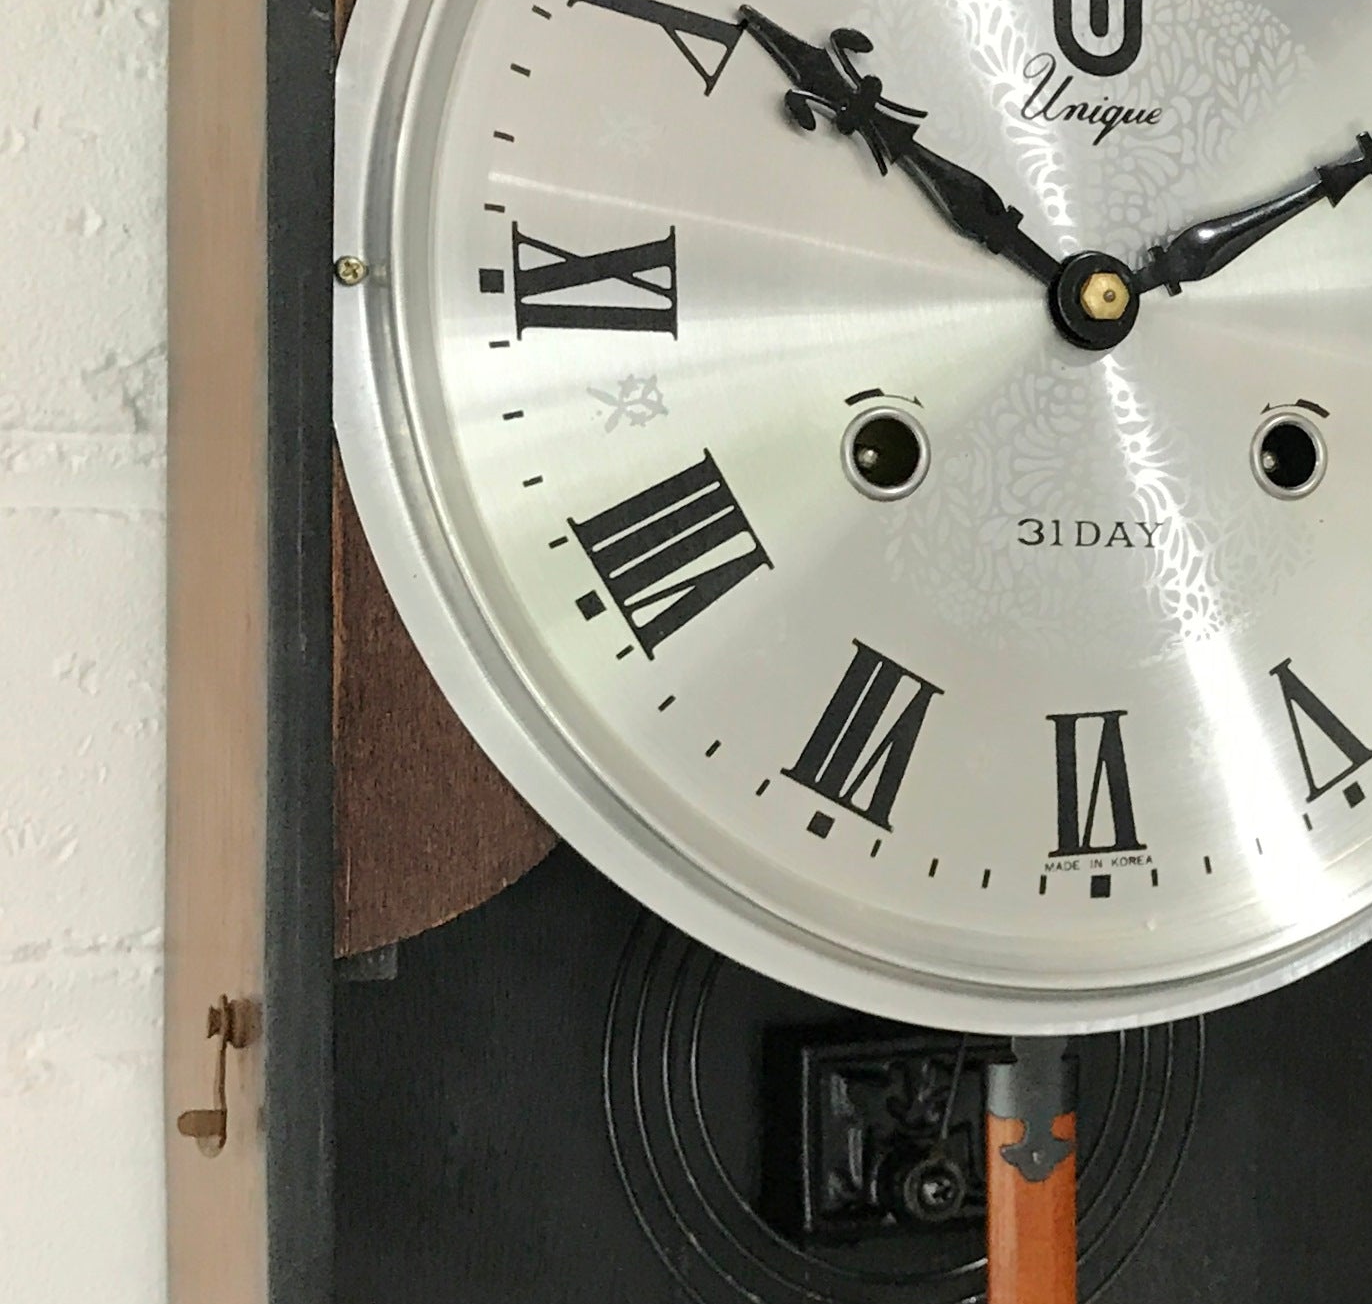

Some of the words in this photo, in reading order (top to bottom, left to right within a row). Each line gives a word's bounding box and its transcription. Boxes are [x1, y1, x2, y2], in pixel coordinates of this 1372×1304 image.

[1021, 52, 1163, 146] Unique
[512, 221, 678, 341] IX
[567, 447, 774, 661] VIII
[780, 638, 945, 833] VII
[1046, 709, 1148, 858] VI
[1044, 860, 1081, 872] MADE
[1090, 858, 1103, 869] IN
[1111, 855, 1153, 868] KOREA
